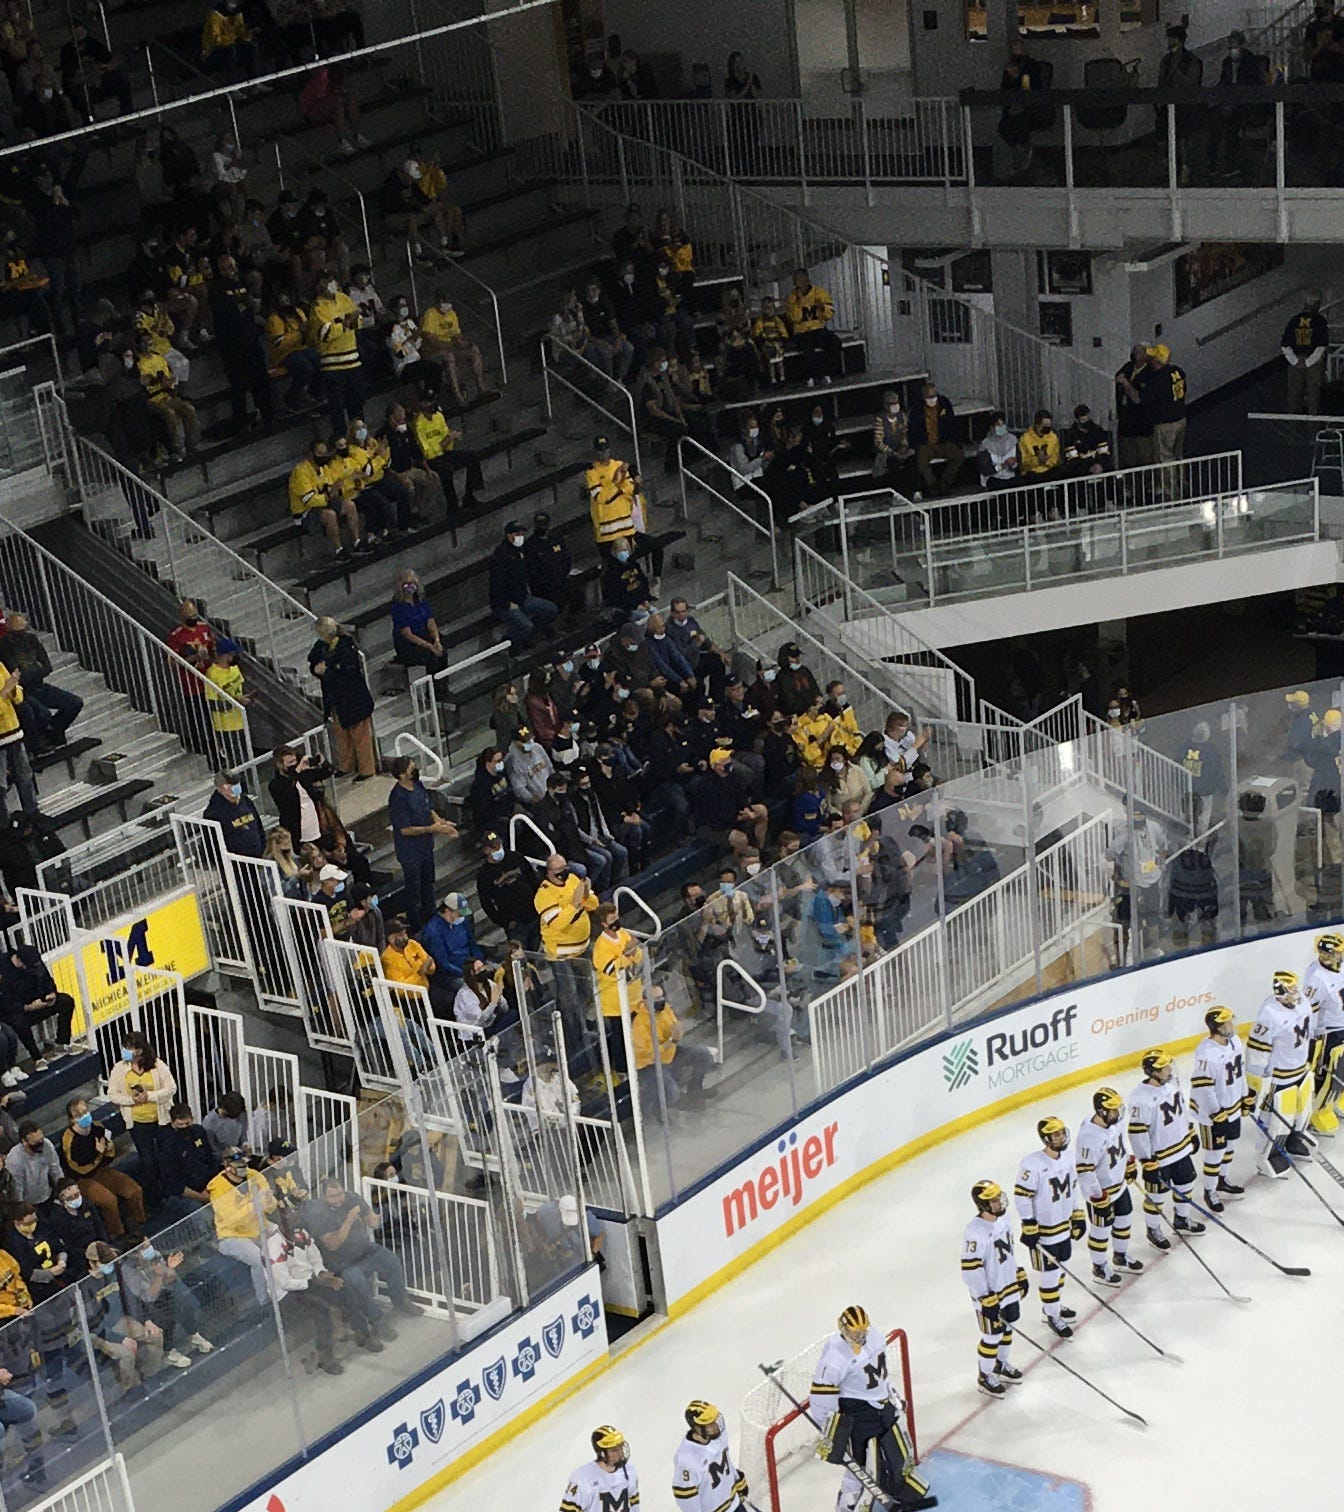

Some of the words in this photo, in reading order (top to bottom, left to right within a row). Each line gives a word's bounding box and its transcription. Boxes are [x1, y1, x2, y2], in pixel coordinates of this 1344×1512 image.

[100, 918, 155, 986] M
[1305, 986, 1318, 999] 31
[1090, 1005, 1161, 1036] Opening
[1163, 992, 1217, 1018] doors.
[1254, 1023, 1269, 1036] 37
[986, 1004, 1078, 1067] Ruoff
[1294, 1015, 1310, 1048] M
[987, 1041, 1080, 1089] MORTGAGE
[1198, 1059, 1208, 1072] 71
[1225, 1054, 1242, 1084] M
[1131, 1106, 1141, 1118] 21
[1160, 1092, 1181, 1127] M
[1107, 1134, 1126, 1169] M
[721, 1120, 839, 1238] meijer
[1048, 1173, 1071, 1203] M
[965, 1240, 977, 1253] 73
[994, 1231, 1014, 1265] M
[864, 1352, 887, 1390] M
[682, 1469, 690, 1482] 9
[708, 1450, 730, 1489] M
